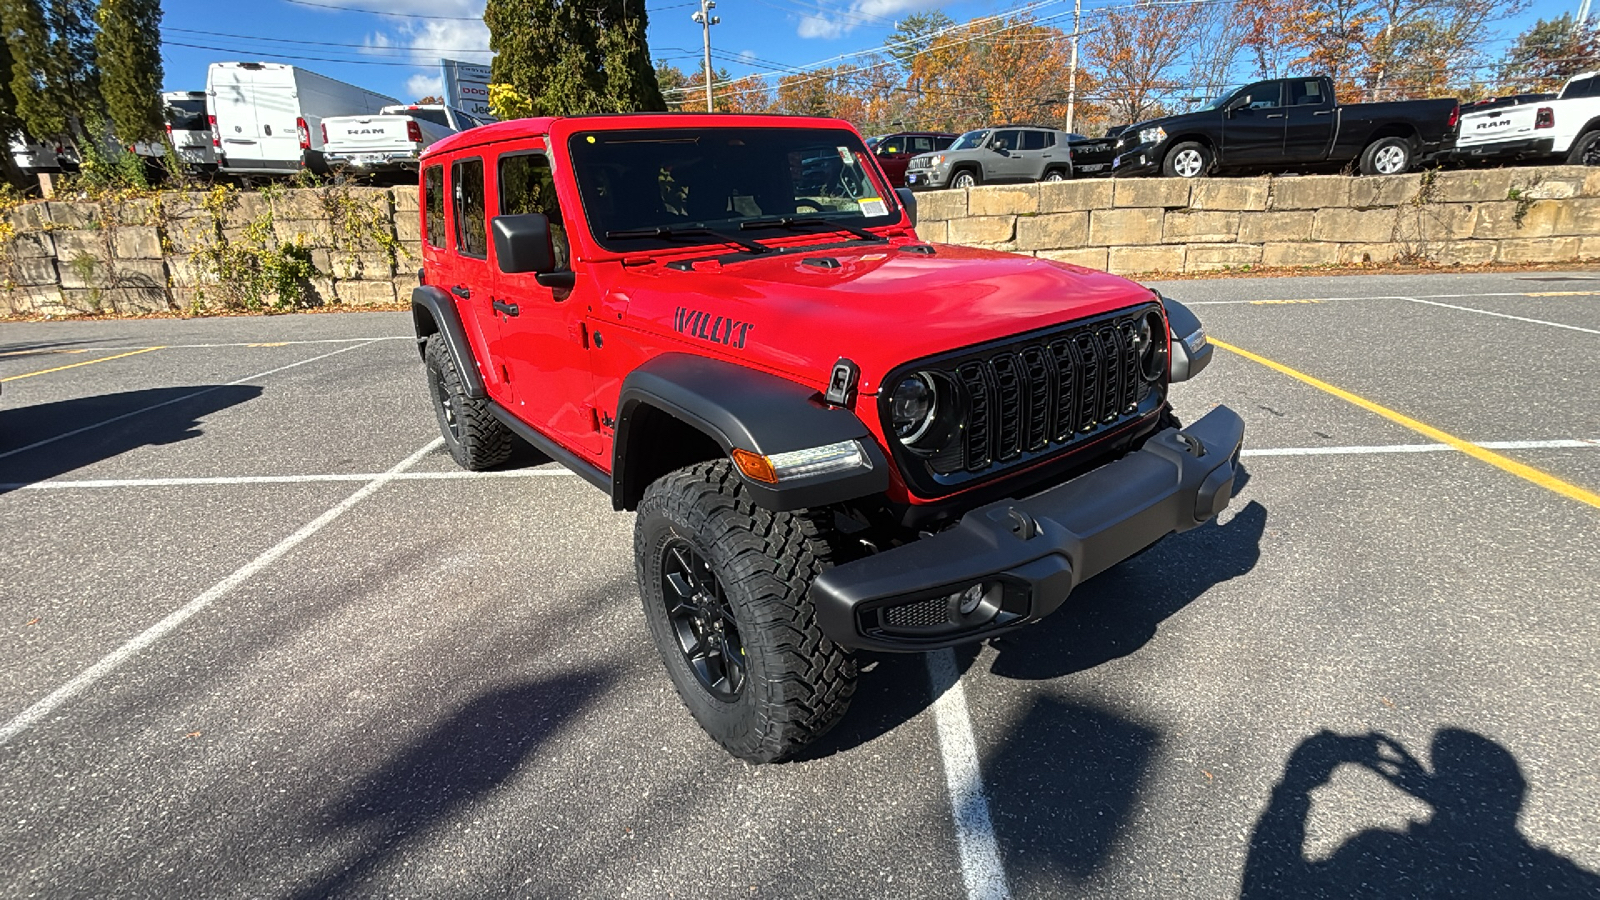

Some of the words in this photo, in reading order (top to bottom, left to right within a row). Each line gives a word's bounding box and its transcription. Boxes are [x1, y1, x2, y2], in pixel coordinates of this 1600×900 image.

[471, 103, 493, 115] Jee
[1476, 119, 1511, 130] RAM
[674, 306, 755, 349] WILLYS
